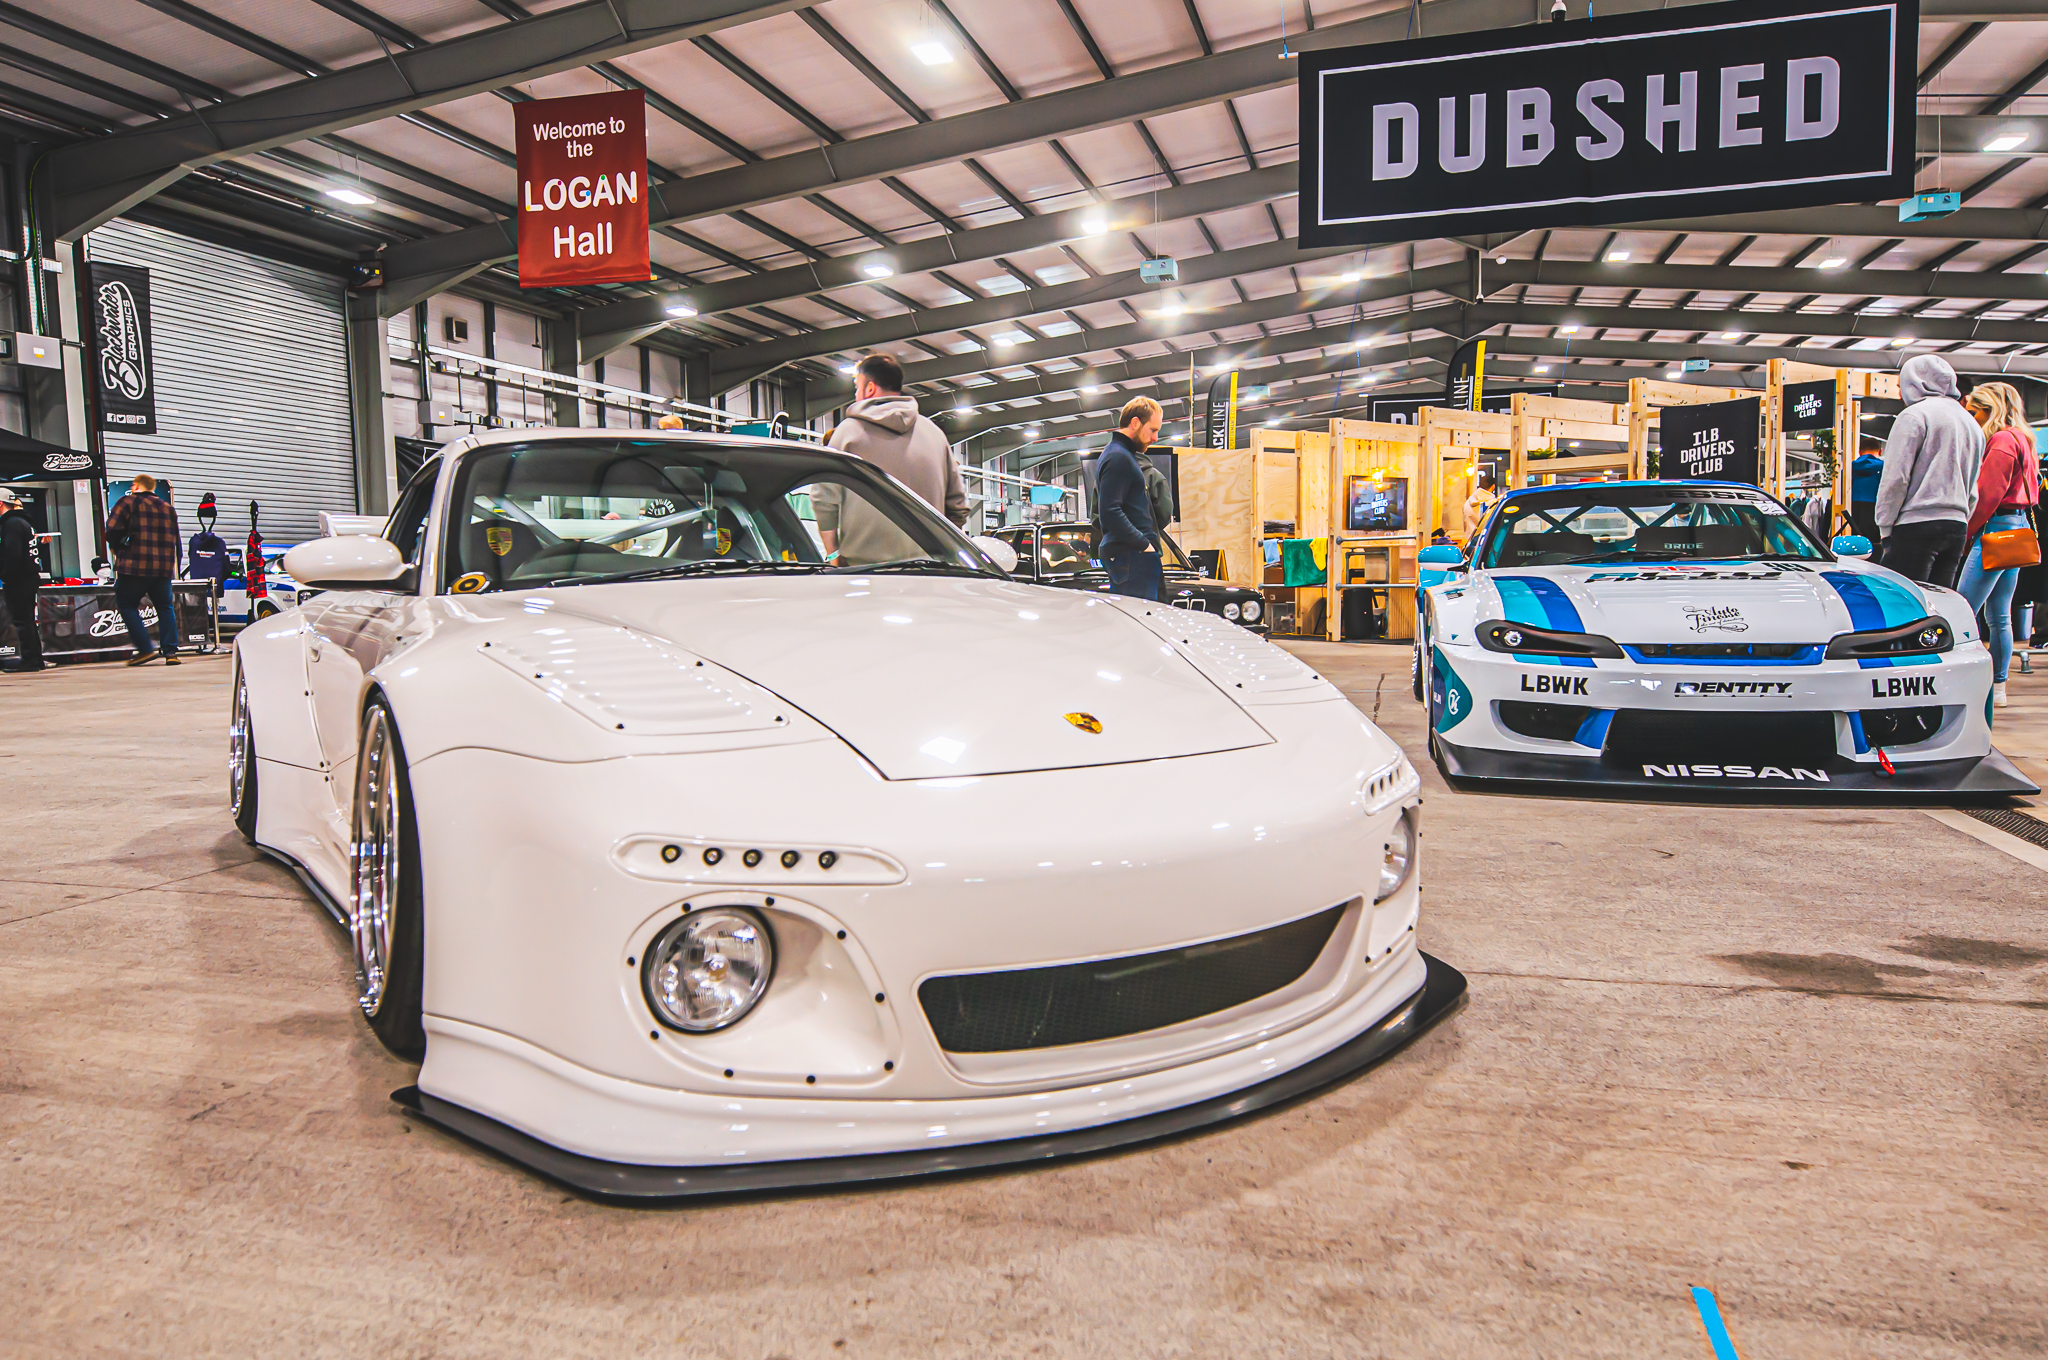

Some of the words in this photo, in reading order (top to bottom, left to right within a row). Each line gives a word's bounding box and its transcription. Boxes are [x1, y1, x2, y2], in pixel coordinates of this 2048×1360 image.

[533, 119, 607, 141] Welcome
[609, 116, 625, 134] to
[1372, 55, 1841, 181] DUBSHED
[566, 140, 593, 158] the
[524, 171, 638, 212] LOGAN
[554, 221, 613, 259] Hall
[99, 281, 146, 400] Blackwater
[123, 299, 138, 361] GRAPHICS
[1794, 399, 1822, 413] DRIVERS
[1800, 393, 1815, 404] ILB
[1799, 407, 1817, 418] CLUB
[1692, 427, 1719, 447] ILB
[1680, 440, 1735, 464] DRIVERS
[1690, 457, 1723, 476] CLUB
[1686, 609, 1742, 631] Finesse
[1521, 673, 1589, 696] LBWK
[1674, 682, 1793, 694] IDENTITY
[1872, 676, 1937, 698] LBWK
[1643, 764, 1831, 783] NISSAN
